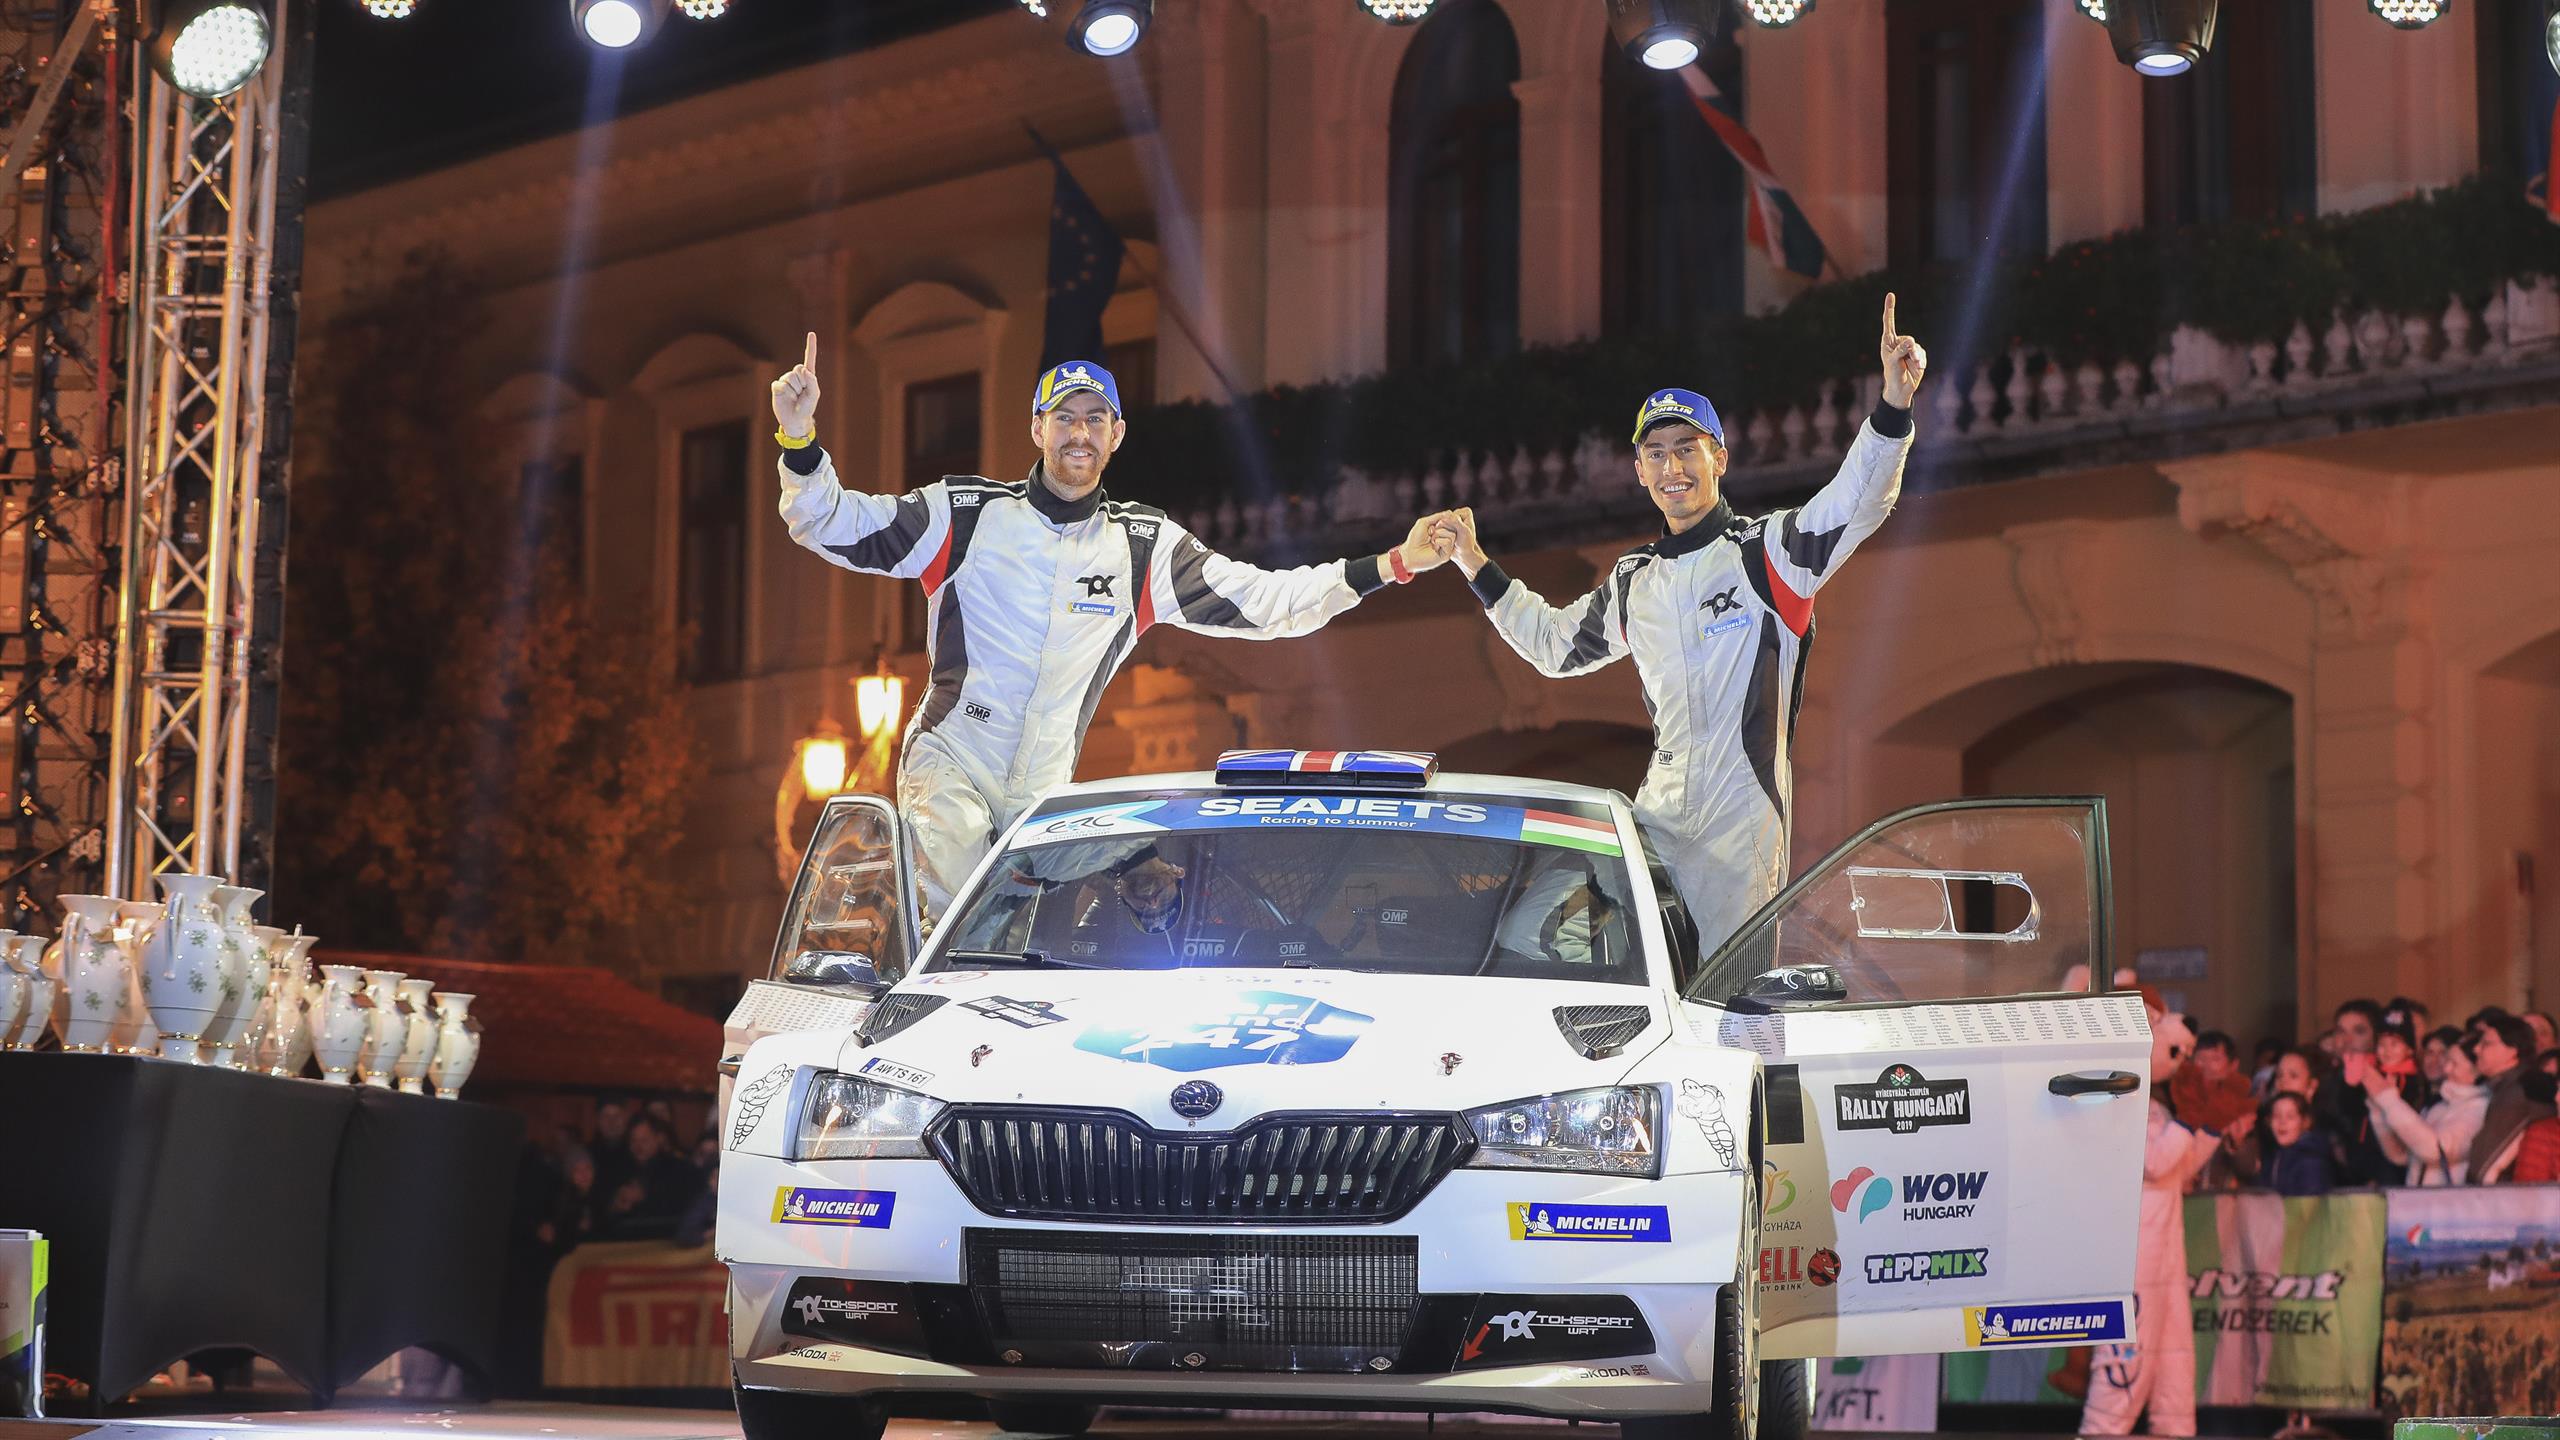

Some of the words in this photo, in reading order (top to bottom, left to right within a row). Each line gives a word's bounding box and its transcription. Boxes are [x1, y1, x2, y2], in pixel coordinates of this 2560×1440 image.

[1053, 379, 1105, 393] MICHELIN
[953, 494, 980, 505] OMP
[1129, 523, 1155, 537] OMP
[1741, 526, 1761, 542] OMP
[1081, 605, 1112, 613] MICHELIN
[1713, 619, 1748, 634] MICHELIN
[965, 704, 991, 719] OMP
[1197, 797, 1488, 823] SEAJETS
[1260, 815, 1319, 827] Racing
[1324, 816, 1341, 825] to
[1347, 818, 1417, 828] summer
[1381, 910, 1408, 923] OMP
[1071, 942, 1098, 955] OMP
[1183, 942, 1225, 957] OMP
[1280, 942, 1306, 955] OMP
[873, 1063, 896, 1074] AW
[892, 1068, 909, 1079] TS
[907, 1072, 928, 1085] 161
[1841, 1095, 1889, 1121] RALLY
[1893, 1090, 1966, 1118] HUNGARY
[1896, 1120, 1913, 1131] 2019
[1902, 1171, 1989, 1203] WOW
[806, 1200, 880, 1216] MICHELIN
[1903, 1204, 1976, 1221] HUNGARY
[1556, 1216, 1651, 1231] MICHELIN
[1762, 1220, 1802, 1232] GYHÁZA
[1760, 1246, 1803, 1284] ELL
[1774, 1284, 1802, 1292] DRINK
[821, 1299, 898, 1311] TOKSPORT
[845, 1311, 870, 1320] WRT
[1536, 1315, 1634, 1326] TOKSPORT
[1567, 1327, 1599, 1335] WRT
[2011, 1315, 2107, 1333] MICHELIN
